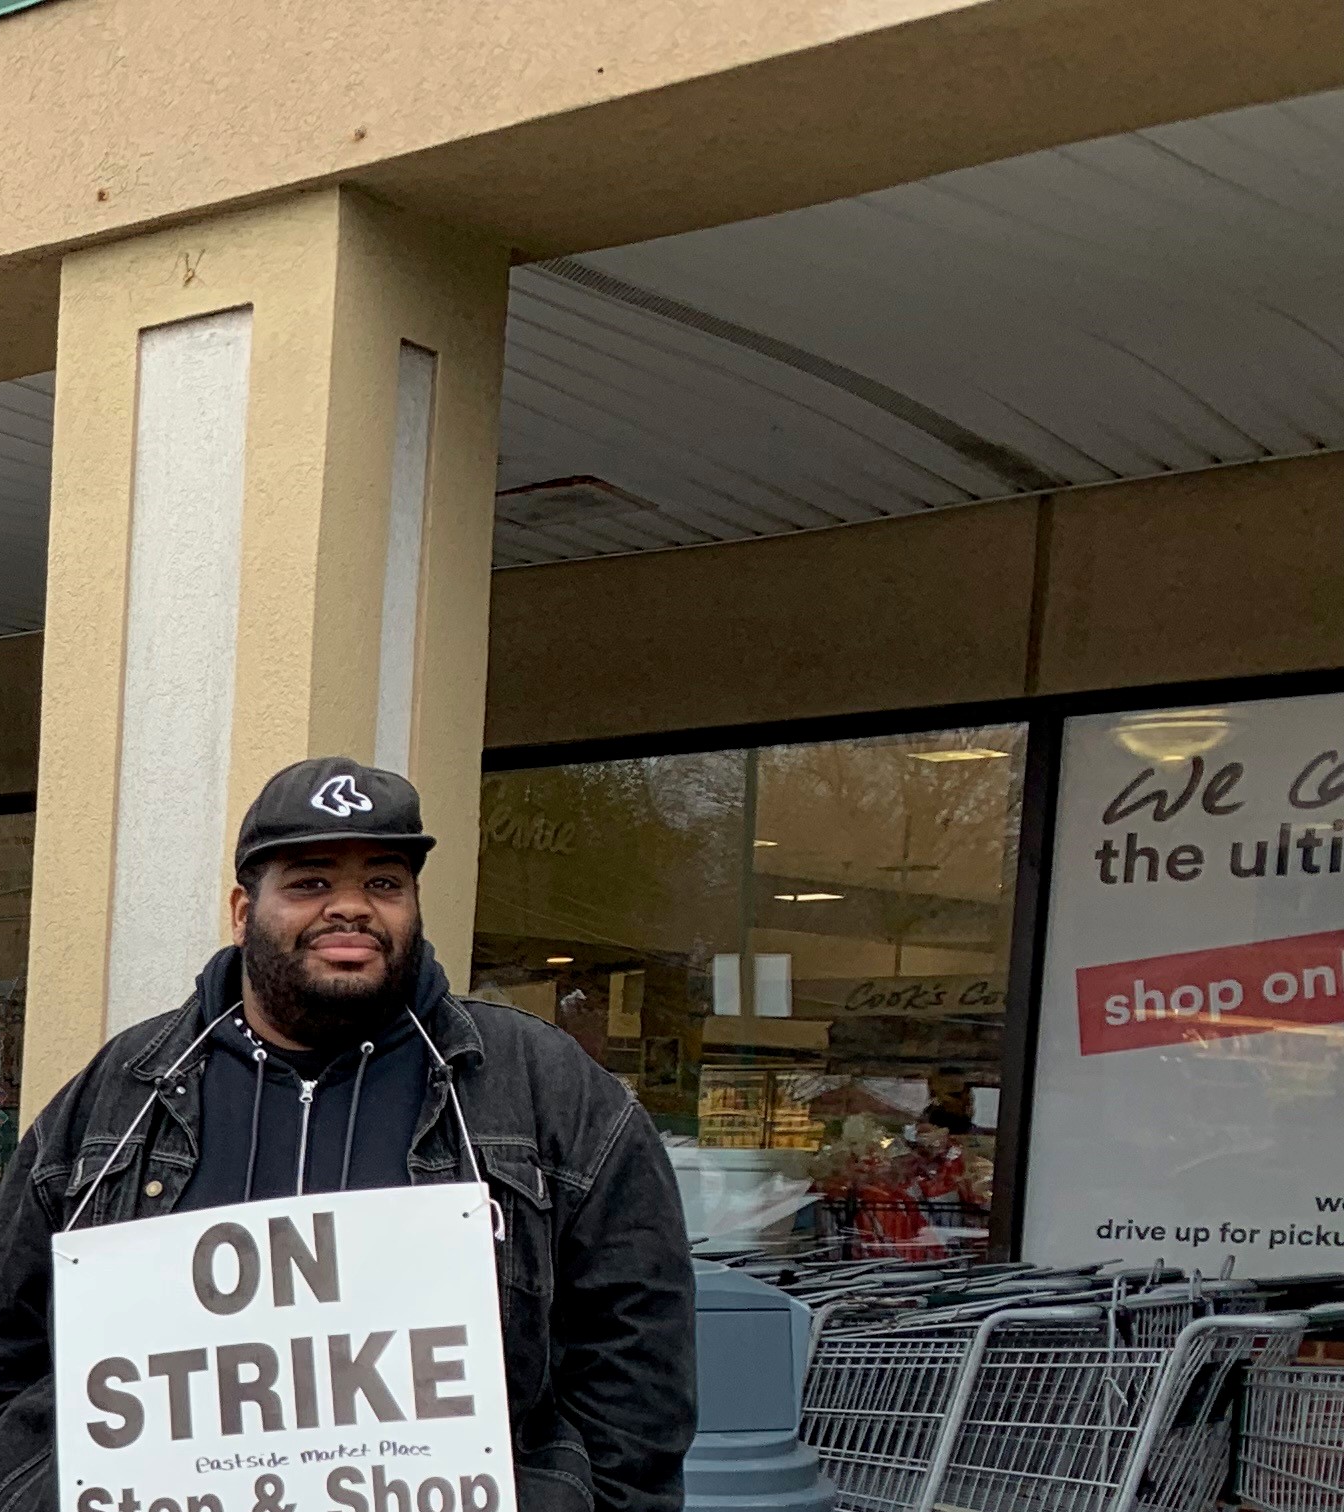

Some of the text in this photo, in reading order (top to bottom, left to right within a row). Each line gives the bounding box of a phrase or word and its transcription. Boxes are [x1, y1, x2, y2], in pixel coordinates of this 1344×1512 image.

[1094, 818, 1344, 885] the ulti
[844, 981, 947, 1012] Cook's
[1104, 955, 1344, 1026] shop on
[191, 1211, 342, 1316] ON
[1096, 1218, 1344, 1250] drive up for picku
[85, 1324, 475, 1449] STRIKE
[378, 1440, 432, 1457] Place
